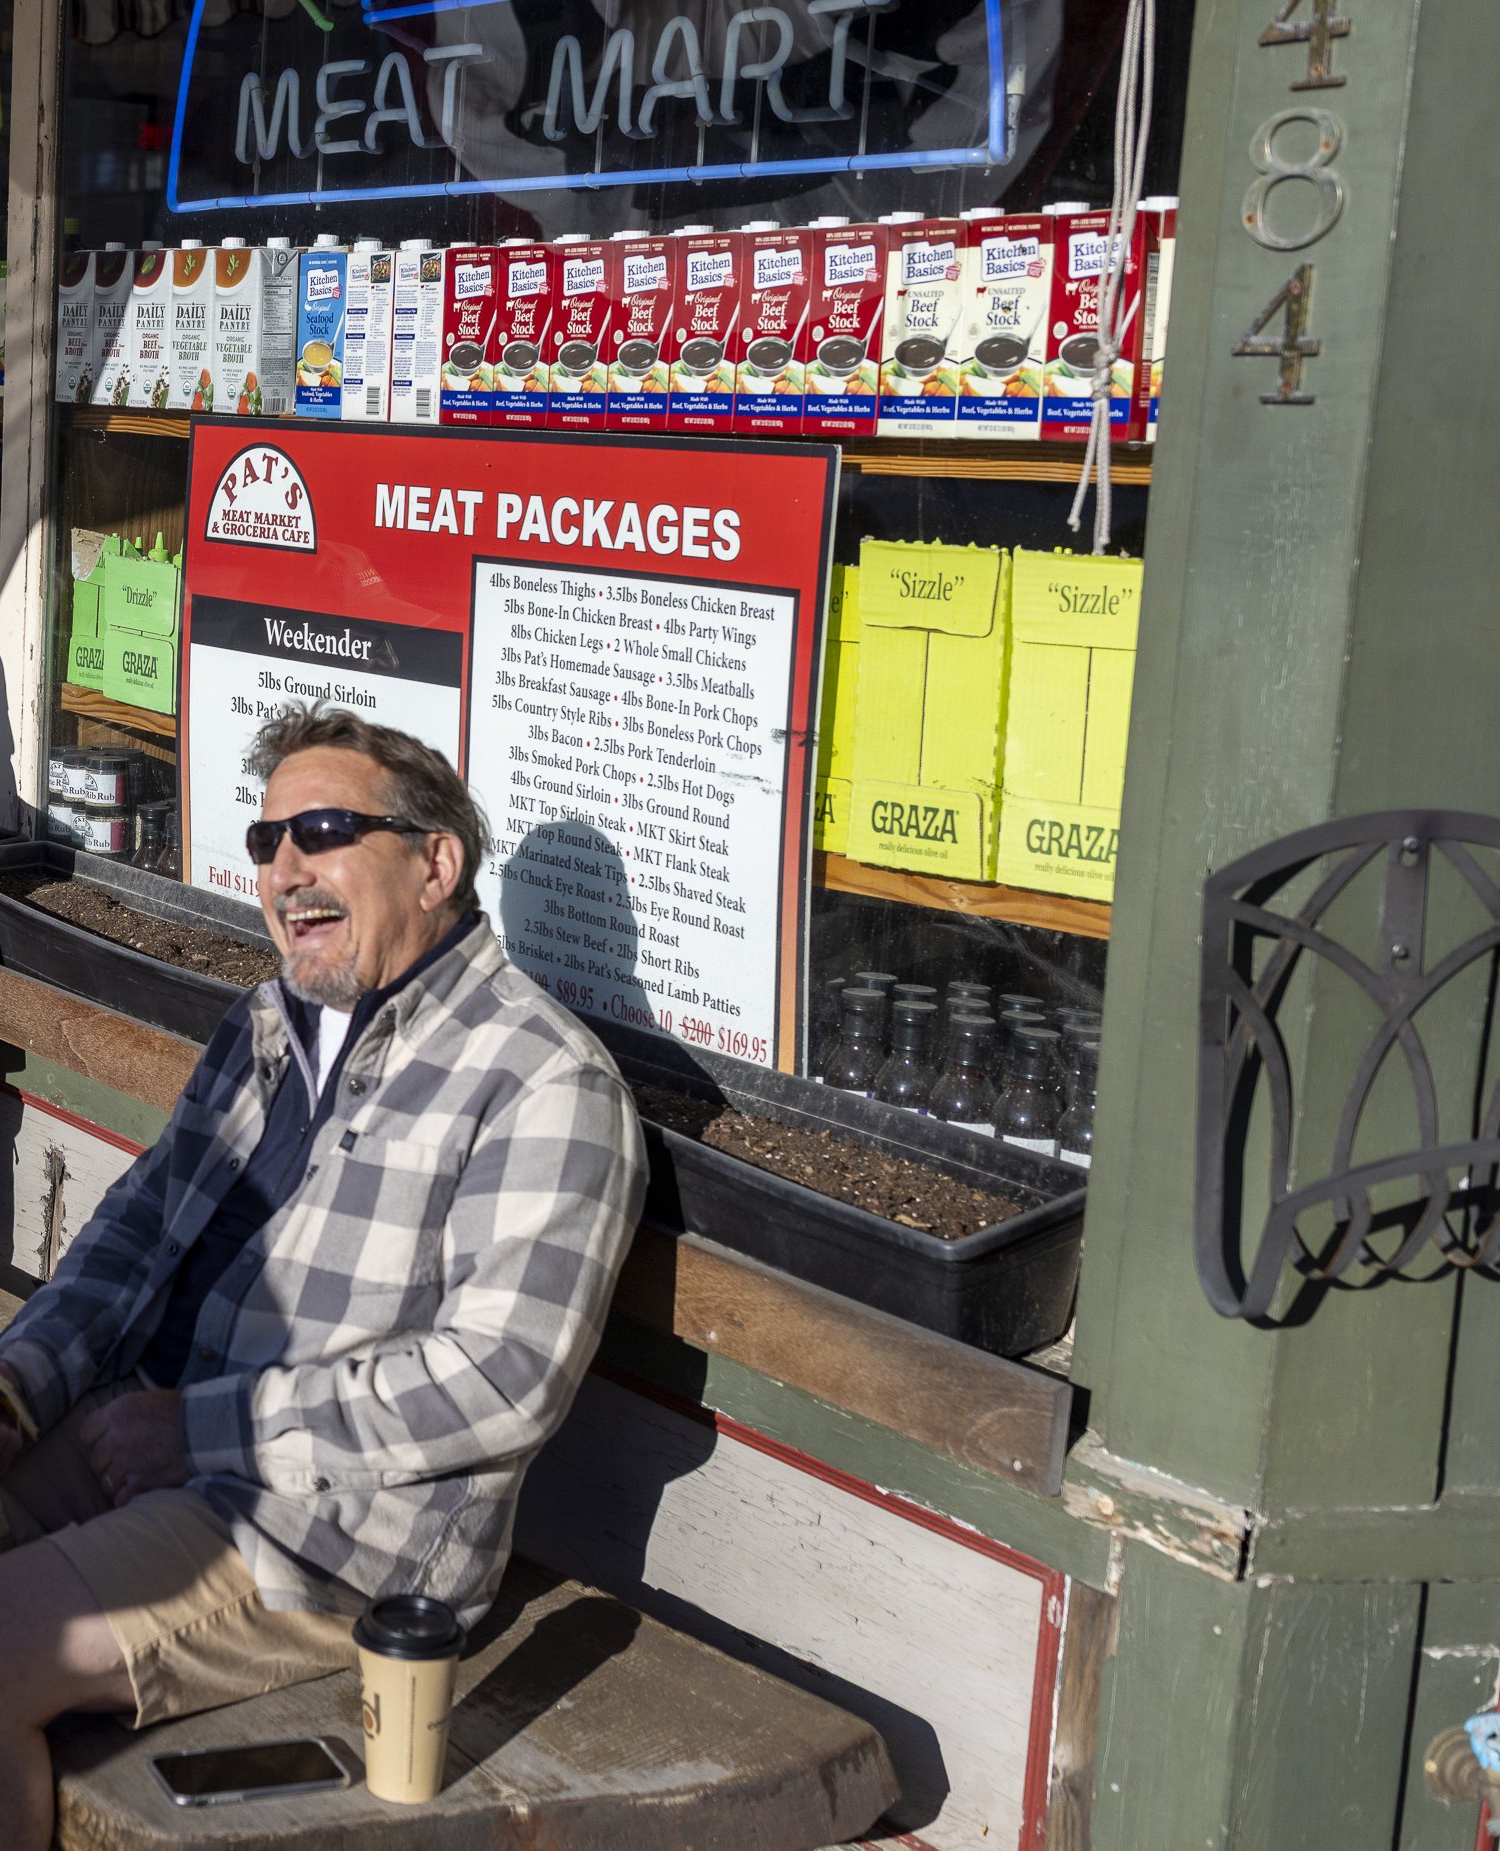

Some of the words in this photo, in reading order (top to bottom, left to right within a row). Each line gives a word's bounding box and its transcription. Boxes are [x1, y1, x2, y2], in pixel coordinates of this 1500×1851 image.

[235, 43, 485, 164] MEAT
[543, 0, 893, 141] MART
[906, 247, 953, 264] Kitchen
[986, 243, 1036, 260] Kitchen
[691, 258, 730, 272] Kitchen
[906, 263, 944, 279] Basics
[986, 259, 1025, 275] Basics
[310, 275, 337, 286] Kitchen
[691, 272, 722, 285] Basics
[310, 287, 332, 296] Basics
[907, 290, 944, 298] UNSALTED
[137, 305, 165, 318] DAILY
[220, 306, 251, 320] DAILY
[695, 304, 716, 317] Beef
[910, 299, 937, 313] Beef
[136, 319, 164, 328] PANTRY
[219, 321, 251, 330] PANTRY
[306, 313, 333, 324] Seafood
[691, 317, 719, 331] Stock
[905, 312, 939, 327] Stock
[310, 323, 329, 335] Stock
[216, 344, 253, 354] VEGETABLE
[223, 354, 244, 364] BROTH
[222, 509, 251, 523] MEAT
[254, 512, 301, 529] MARKET
[375, 483, 483, 536] MEAT
[497, 492, 742, 562] PACKAGES
[212, 522, 220, 533] &
[222, 523, 279, 540] GROCERIA
[282, 528, 310, 544] CAFE
[490, 572, 510, 587] 4lbs
[513, 575, 557, 593] Boneless
[561, 580, 595, 600] Thighs
[606, 586, 637, 602] 3.5lbs
[641, 589, 687, 608] Boneless
[691, 595, 735, 615] Chicken
[740, 601, 774, 620] Breast
[504, 598, 524, 614] 5lbs
[527, 601, 568, 619] Bone-In
[572, 607, 615, 625] Chicken
[619, 612, 652, 630] Breast
[663, 618, 685, 634] 4lbs
[689, 621, 718, 643] Party
[722, 626, 756, 648] Wings
[264, 617, 372, 660] Weekender
[511, 624, 531, 639] 8lbs
[534, 627, 576, 645] Chicken
[580, 633, 603, 653] Legs
[614, 638, 619, 651] 2
[624, 639, 658, 657] Whole
[662, 644, 692, 662] Small
[696, 649, 745, 670] Chickens
[123, 651, 158, 679] GRAZA
[501, 647, 521, 662] 3lbs
[550, 654, 610, 675] Homemade
[613, 663, 655, 686] Sausage
[666, 671, 697, 689] 3.5lbs
[701, 677, 754, 698] Meatballs
[258, 672, 281, 691] 5lbs
[284, 676, 331, 700] Ground
[334, 684, 377, 709] Sirloin
[231, 697, 253, 716] 3lbs
[495, 671, 515, 686] 3lbs
[519, 674, 566, 694] Breakfast
[570, 682, 610, 705] Sausage
[621, 690, 642, 706] 4lbs
[646, 694, 689, 715] Bone-In
[694, 702, 719, 720] Pork
[723, 707, 757, 729] Chops
[492, 694, 511, 709] 5lbs
[515, 698, 558, 721] Country
[561, 705, 585, 724] Style
[589, 710, 611, 726] Ribs
[622, 716, 643, 732] 3lbs
[647, 720, 694, 741] Boneless
[698, 729, 723, 747] Pork
[727, 735, 761, 756] Chops
[97, 793, 115, 801] Rub
[235, 786, 257, 807] 2lbs
[871, 799, 957, 844] GRAZA
[209, 865, 231, 889] Full
[557, 980, 593, 1009] $89.95
[611, 994, 655, 1028] Choose
[659, 1009, 672, 1033] 10
[718, 1027, 766, 1062] $169.95
